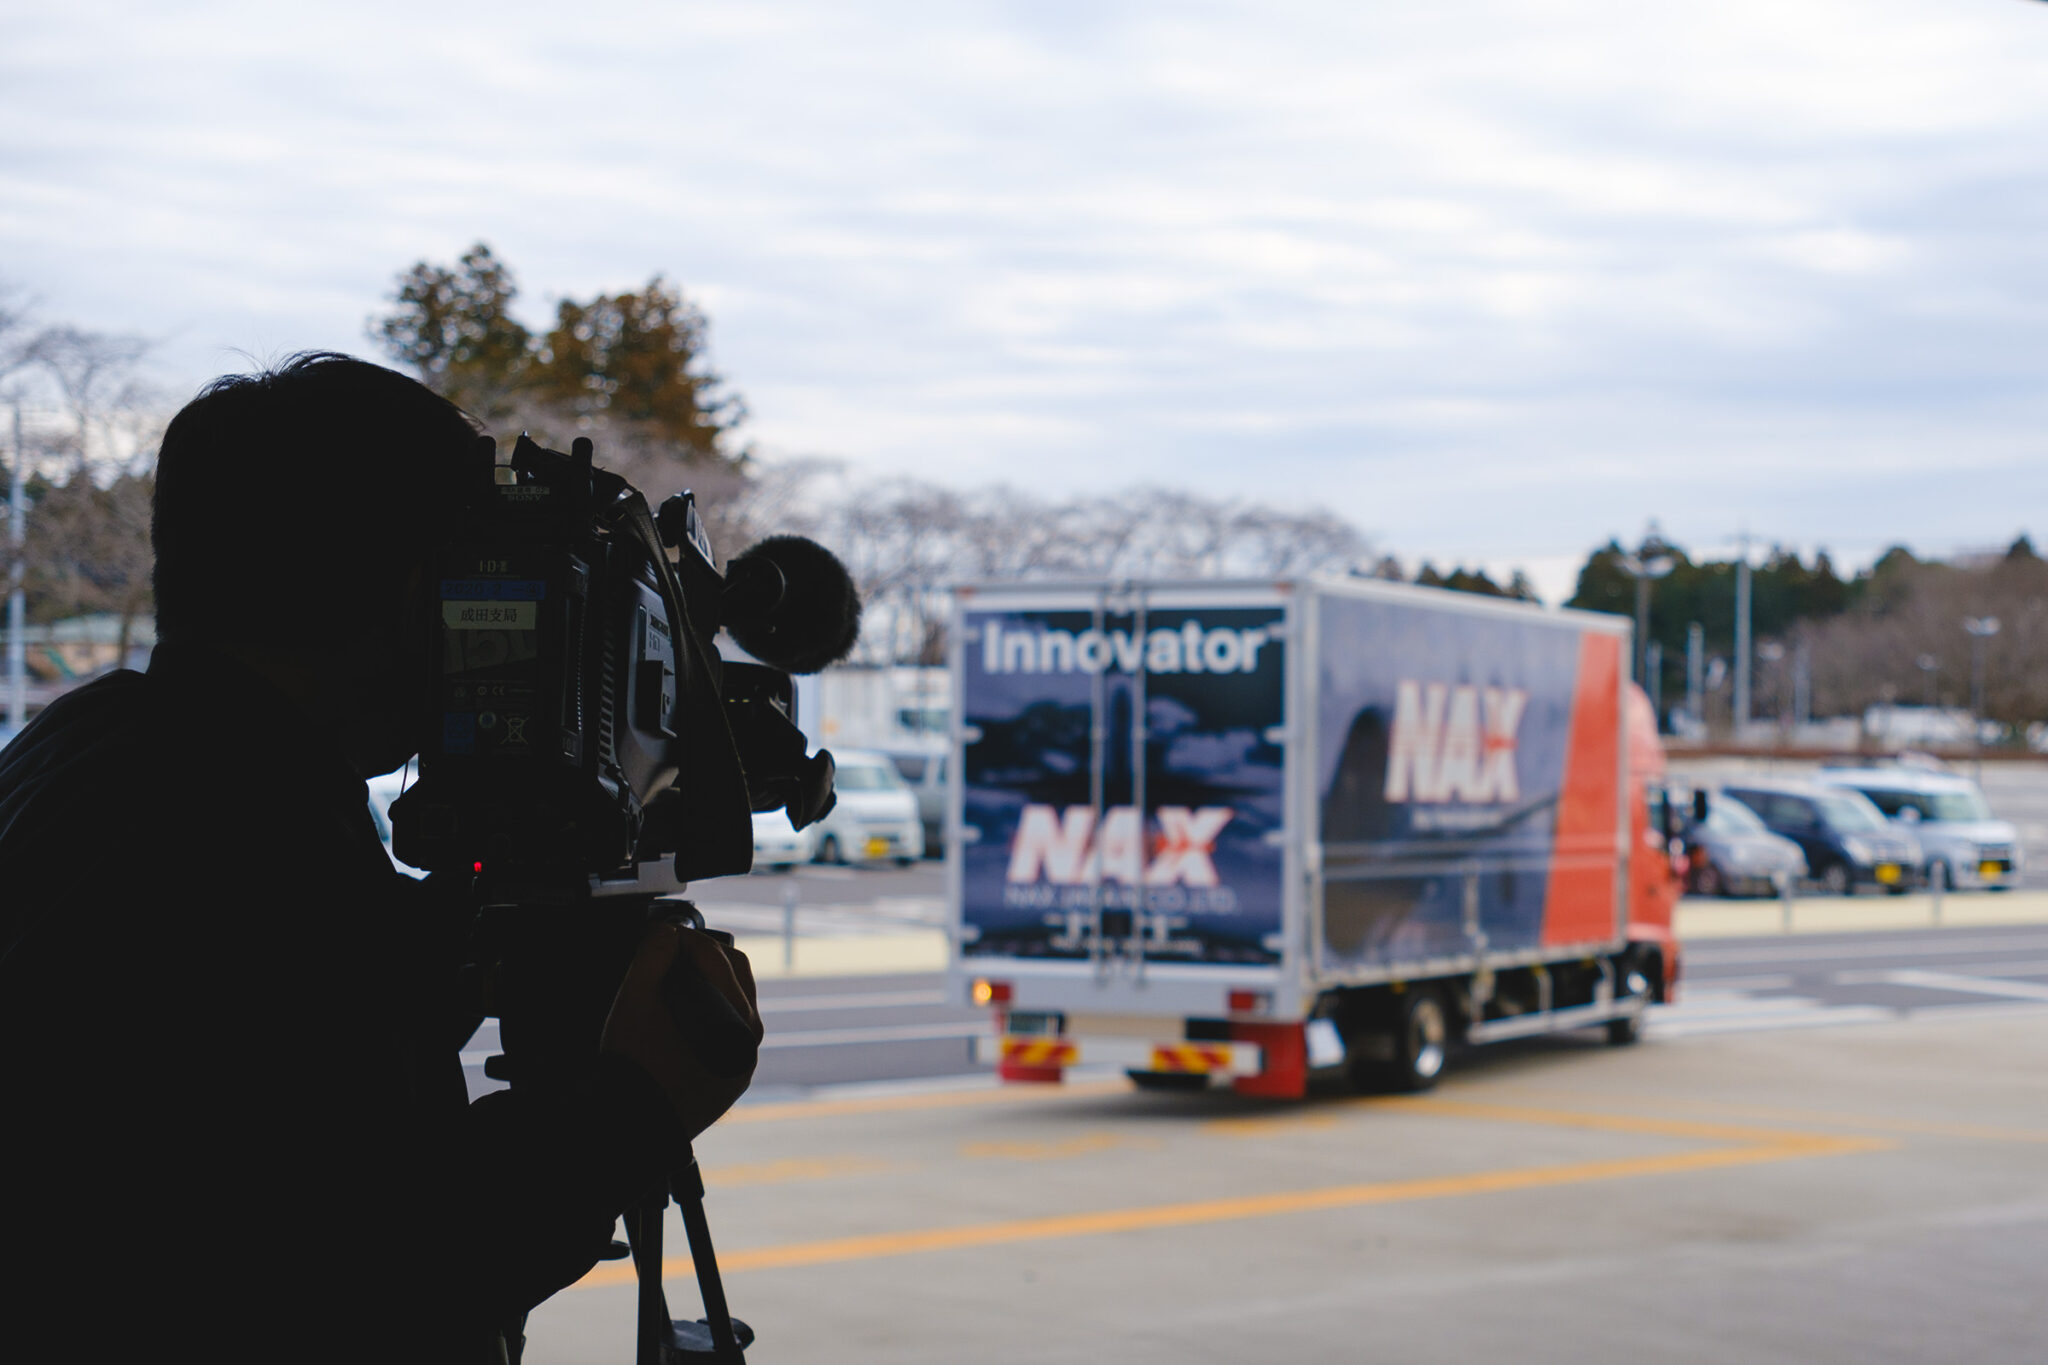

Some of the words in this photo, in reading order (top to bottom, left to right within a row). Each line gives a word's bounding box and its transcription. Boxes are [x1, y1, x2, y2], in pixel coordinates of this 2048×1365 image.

[459, 607, 518, 623] 成田支局
[982, 618, 1265, 674] Innovator
[1384, 680, 1527, 803] NAX
[1007, 803, 1235, 887] NAX
